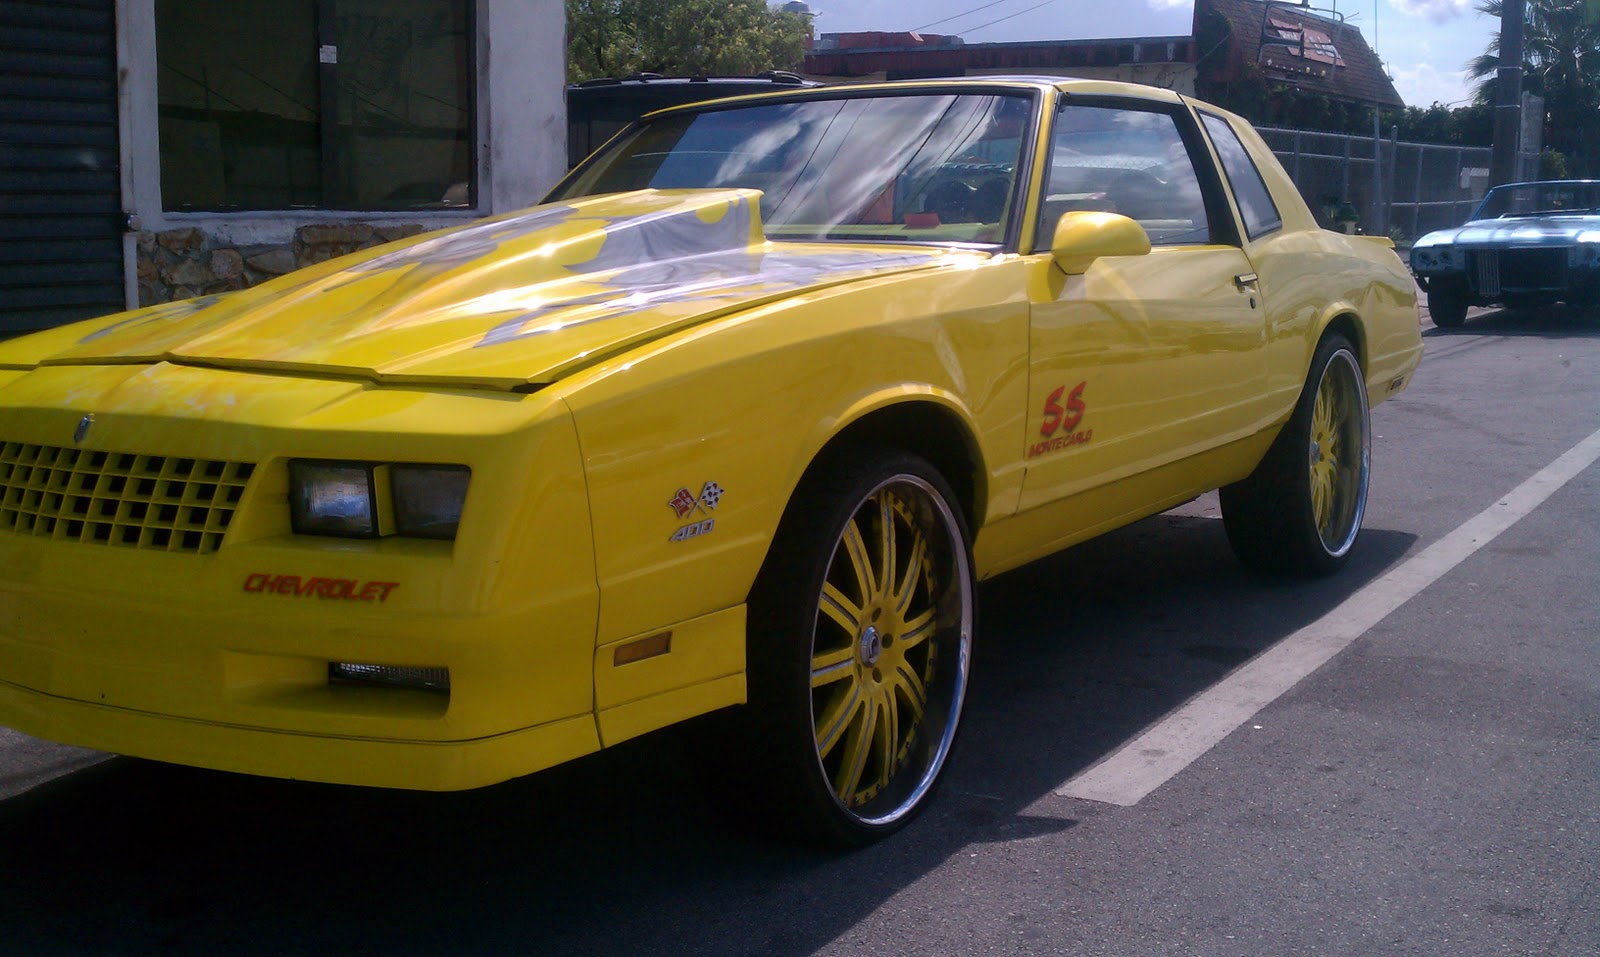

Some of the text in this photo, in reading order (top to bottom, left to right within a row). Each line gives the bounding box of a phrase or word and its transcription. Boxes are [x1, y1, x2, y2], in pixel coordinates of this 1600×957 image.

[1040, 381, 1087, 438] SS
[669, 518, 715, 542] 400
[243, 573, 400, 603] CHEVROLET
